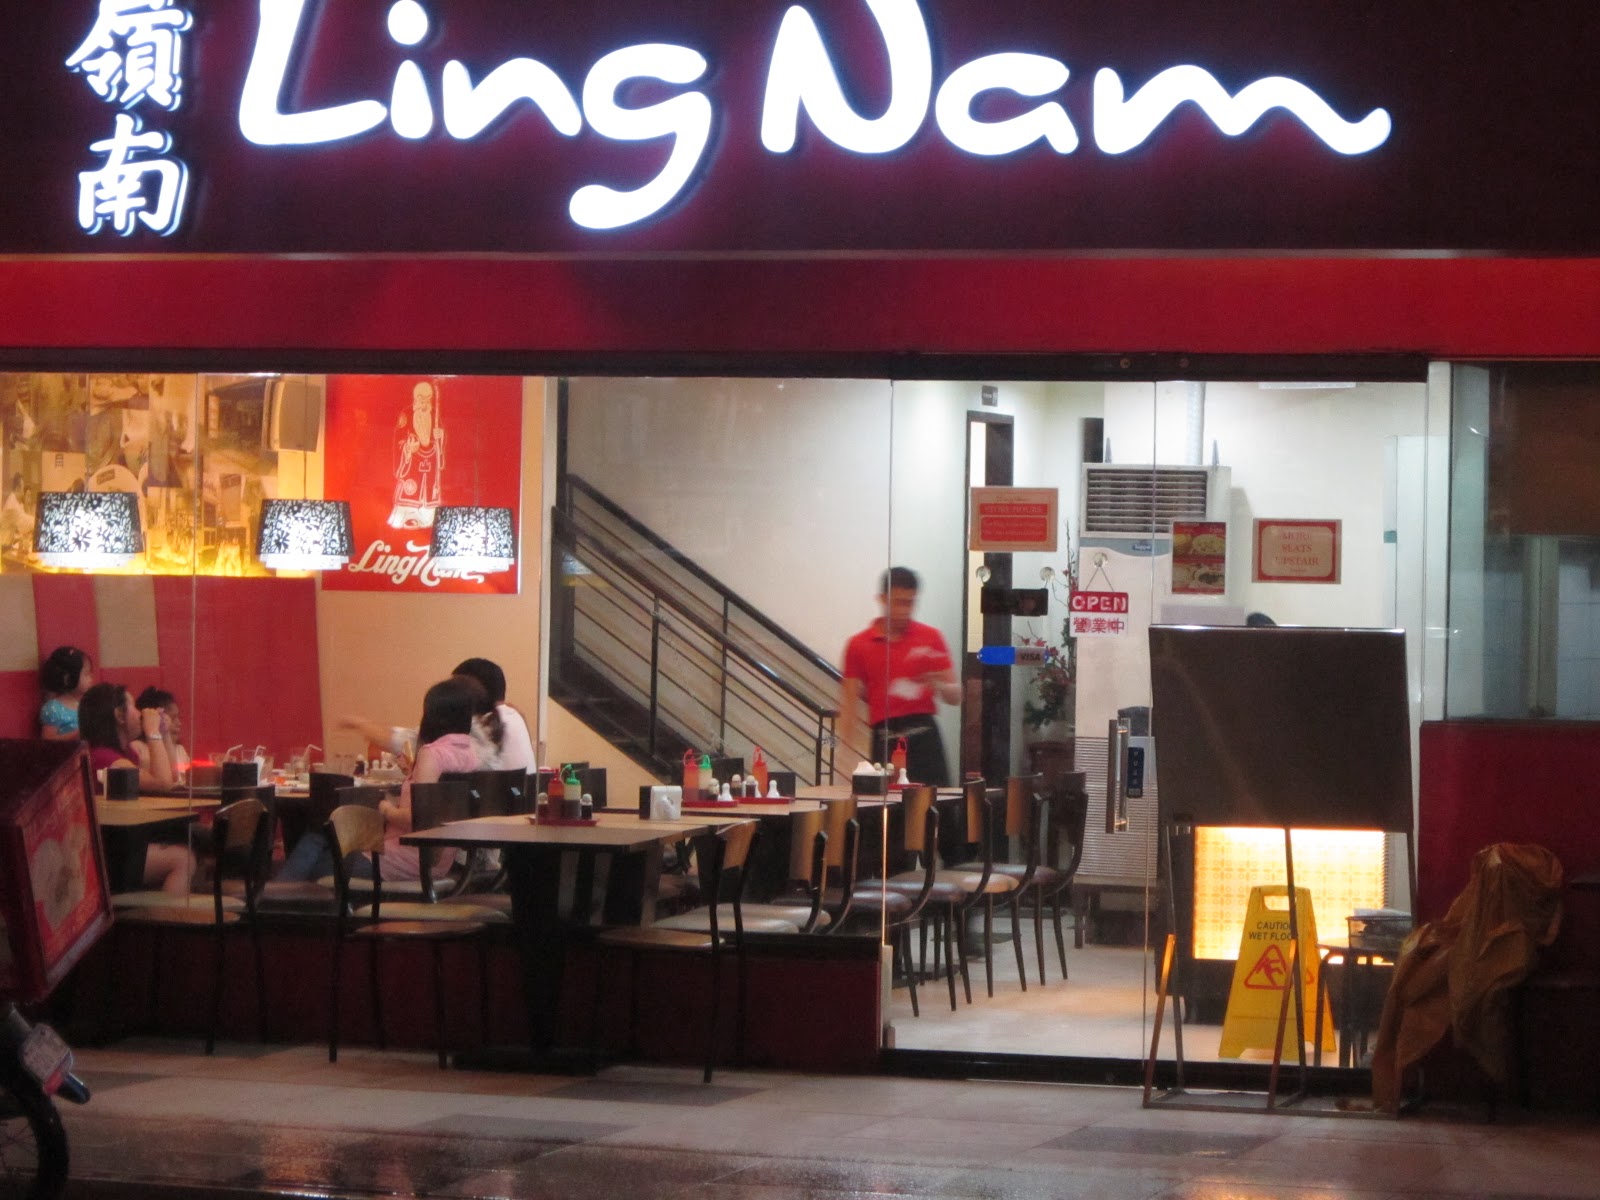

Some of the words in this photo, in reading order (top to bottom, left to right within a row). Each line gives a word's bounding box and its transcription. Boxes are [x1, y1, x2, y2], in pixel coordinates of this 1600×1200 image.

[238, 0, 712, 230] Ling
[760, 0, 1392, 155] Nam
[1281, 543, 1313, 553] SEATS
[1071, 595, 1128, 612] OPEN
[1073, 616, 1125, 634] 營業中
[1019, 651, 1041, 661] VISA
[1256, 921, 1292, 930] CAUTIO
[1248, 932, 1268, 940] WET
[1270, 932, 1293, 941] FLOO
